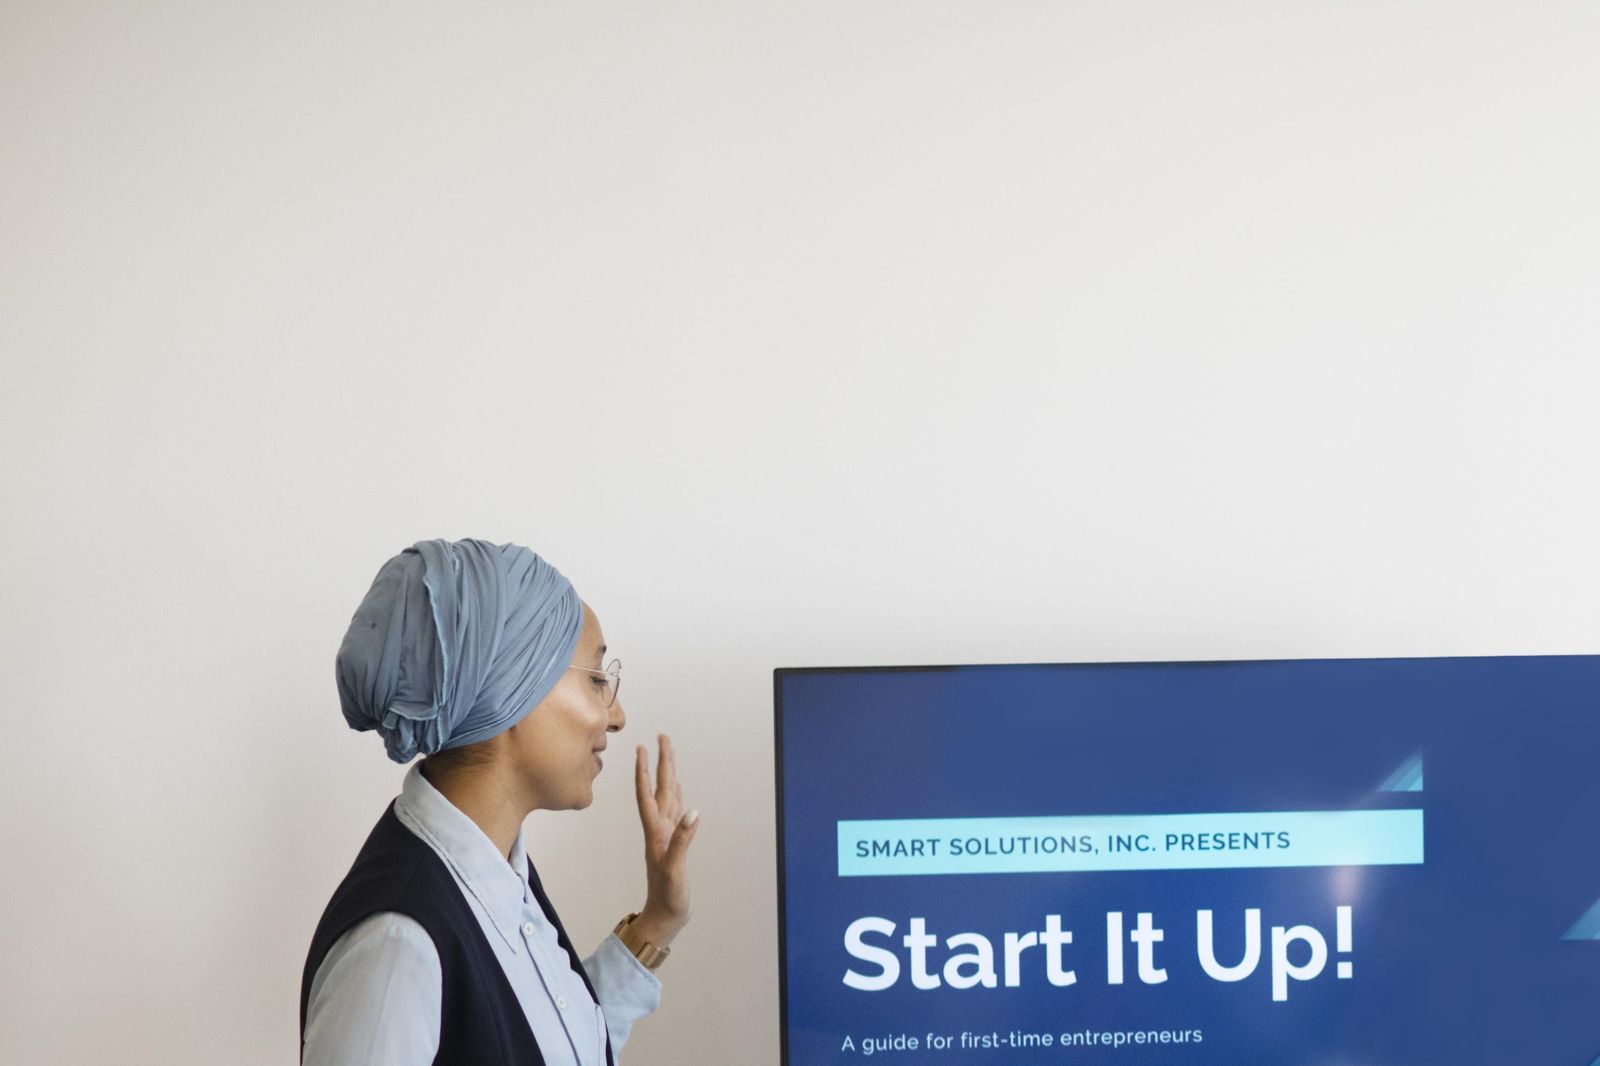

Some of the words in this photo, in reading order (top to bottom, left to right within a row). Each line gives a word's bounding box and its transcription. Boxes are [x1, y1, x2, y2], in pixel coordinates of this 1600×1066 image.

[855, 838, 942, 858] SMART
[949, 834, 1100, 858] SOLUTIONS,
[1108, 833, 1156, 853] INC.
[1165, 831, 1291, 852] PRESENTS
[842, 913, 1077, 991] Start
[1106, 911, 1168, 985] It
[1196, 905, 1353, 1002] Up!
[841, 1035, 856, 1052] A
[862, 1033, 920, 1056] guide
[925, 1032, 954, 1050] for
[960, 1030, 1054, 1049] first-time
[1060, 1029, 1203, 1049] entrepreneurs
